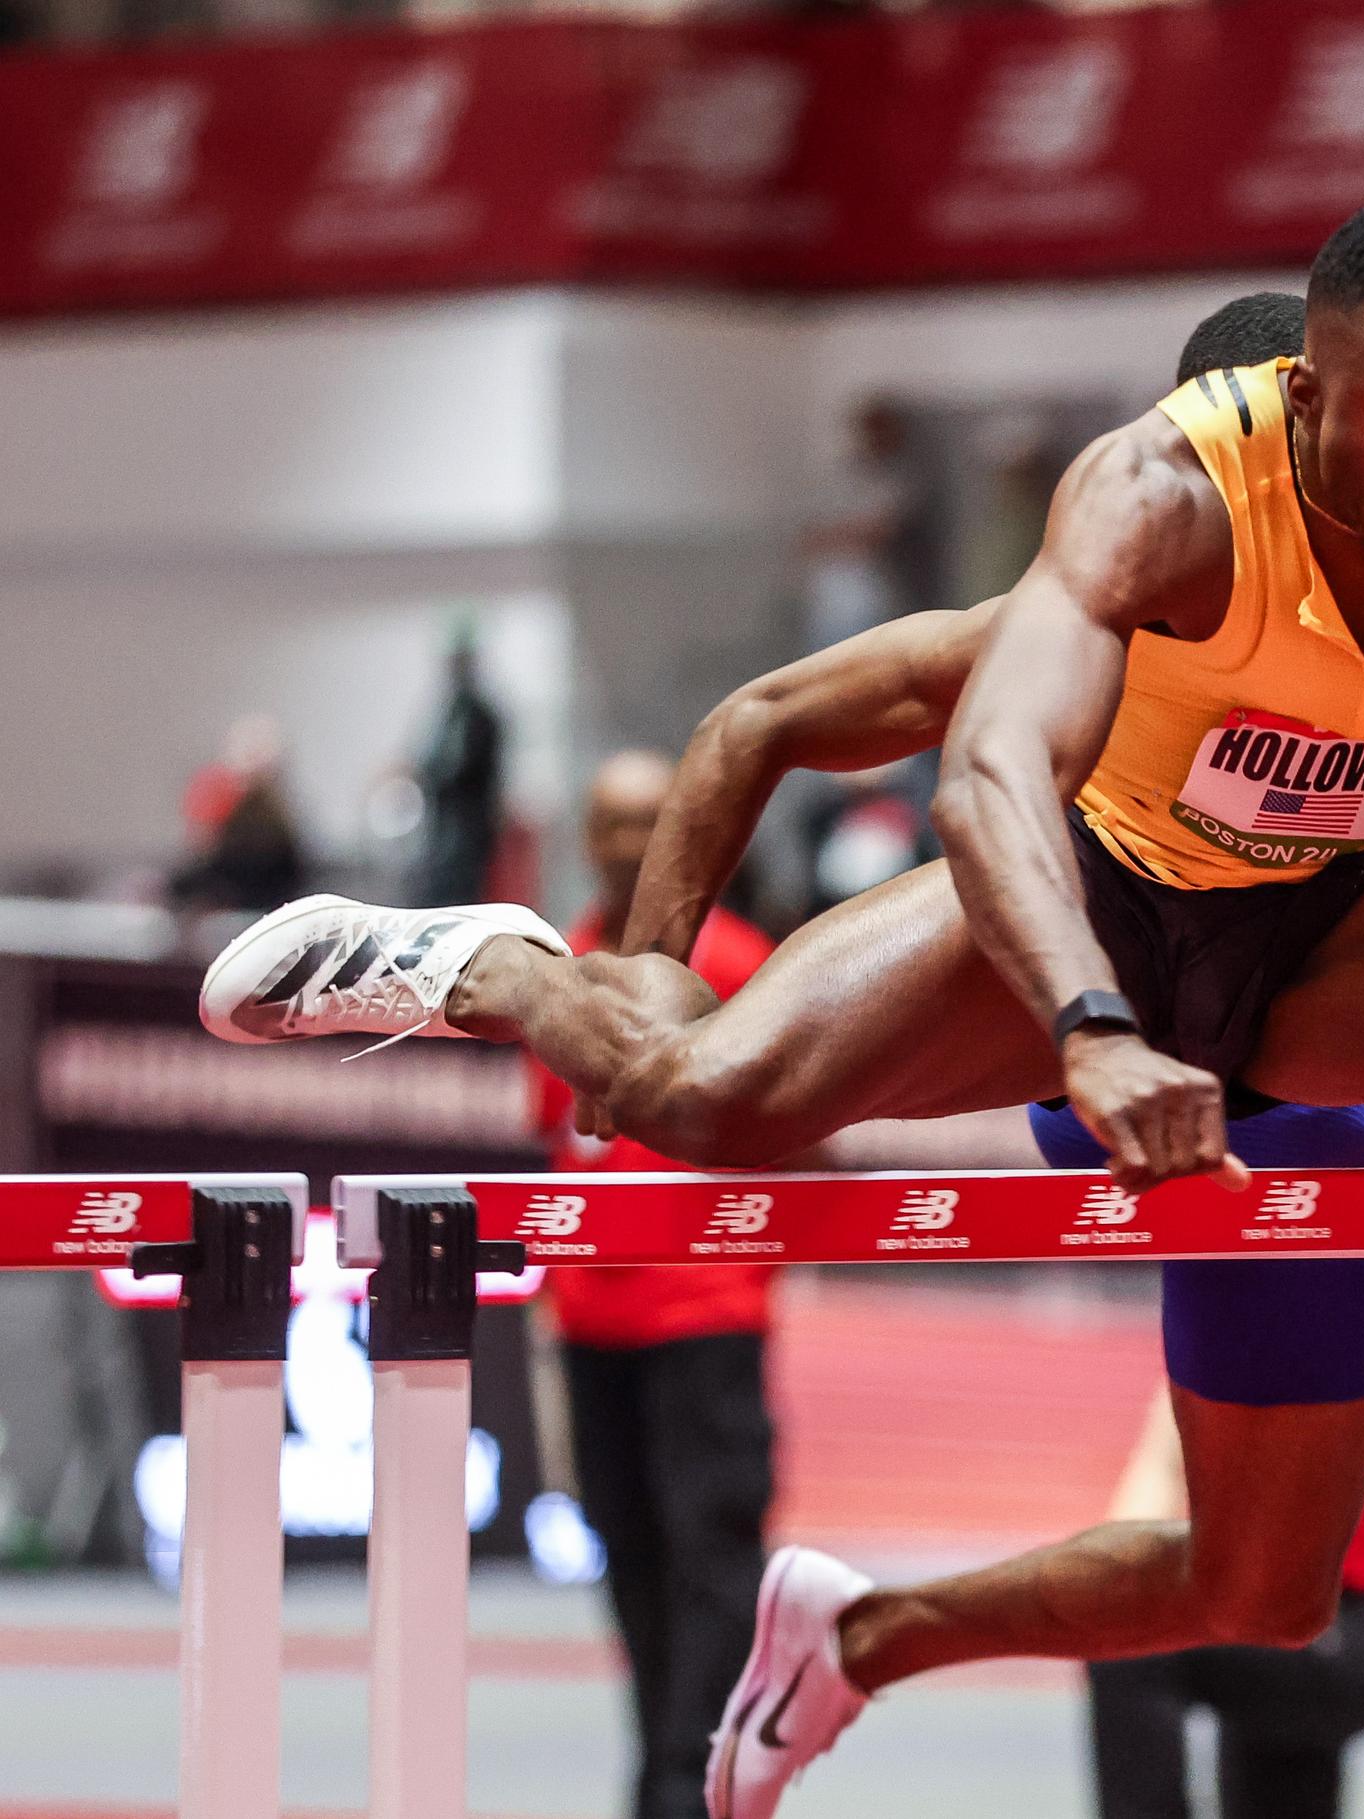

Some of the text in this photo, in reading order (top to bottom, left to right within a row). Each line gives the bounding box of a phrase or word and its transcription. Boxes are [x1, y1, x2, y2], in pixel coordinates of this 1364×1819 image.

[1178, 807, 1296, 864] BOSTON
[1060, 1230, 1154, 1245] new balance
[1241, 1226, 1332, 1240] new balance
[52, 1242, 85, 1254] new
[532, 1240, 598, 1255] balance
[689, 1239, 785, 1254] new balance
[876, 1235, 970, 1250] new balance
